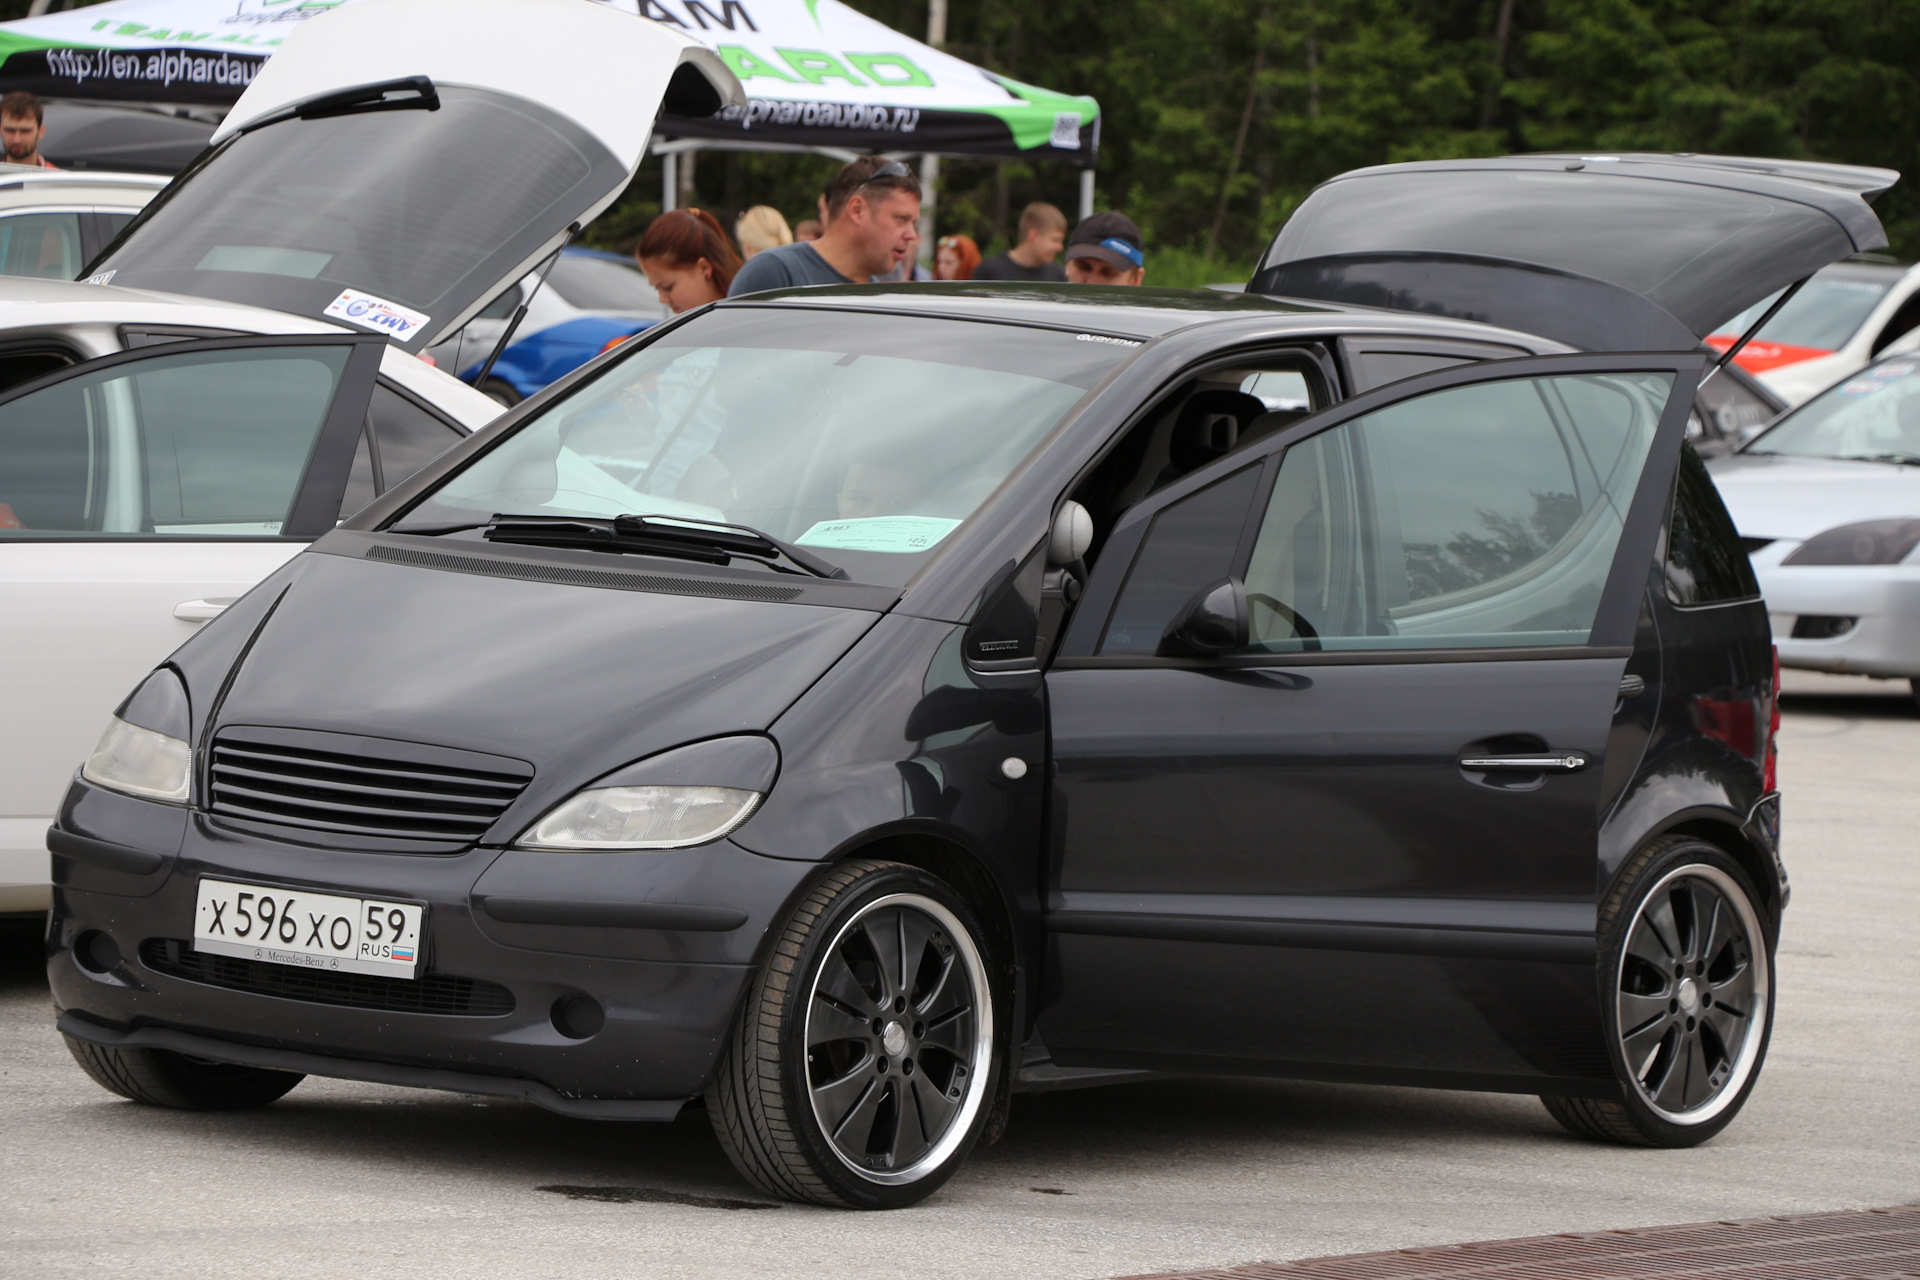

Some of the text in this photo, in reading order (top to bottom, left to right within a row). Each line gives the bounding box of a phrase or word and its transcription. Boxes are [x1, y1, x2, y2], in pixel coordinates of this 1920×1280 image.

[602, 0, 758, 31] AM
[366, 906, 406, 943] 59
[268, 951, 324, 967] Mercedes-Benz
[361, 943, 390, 957] RUS
